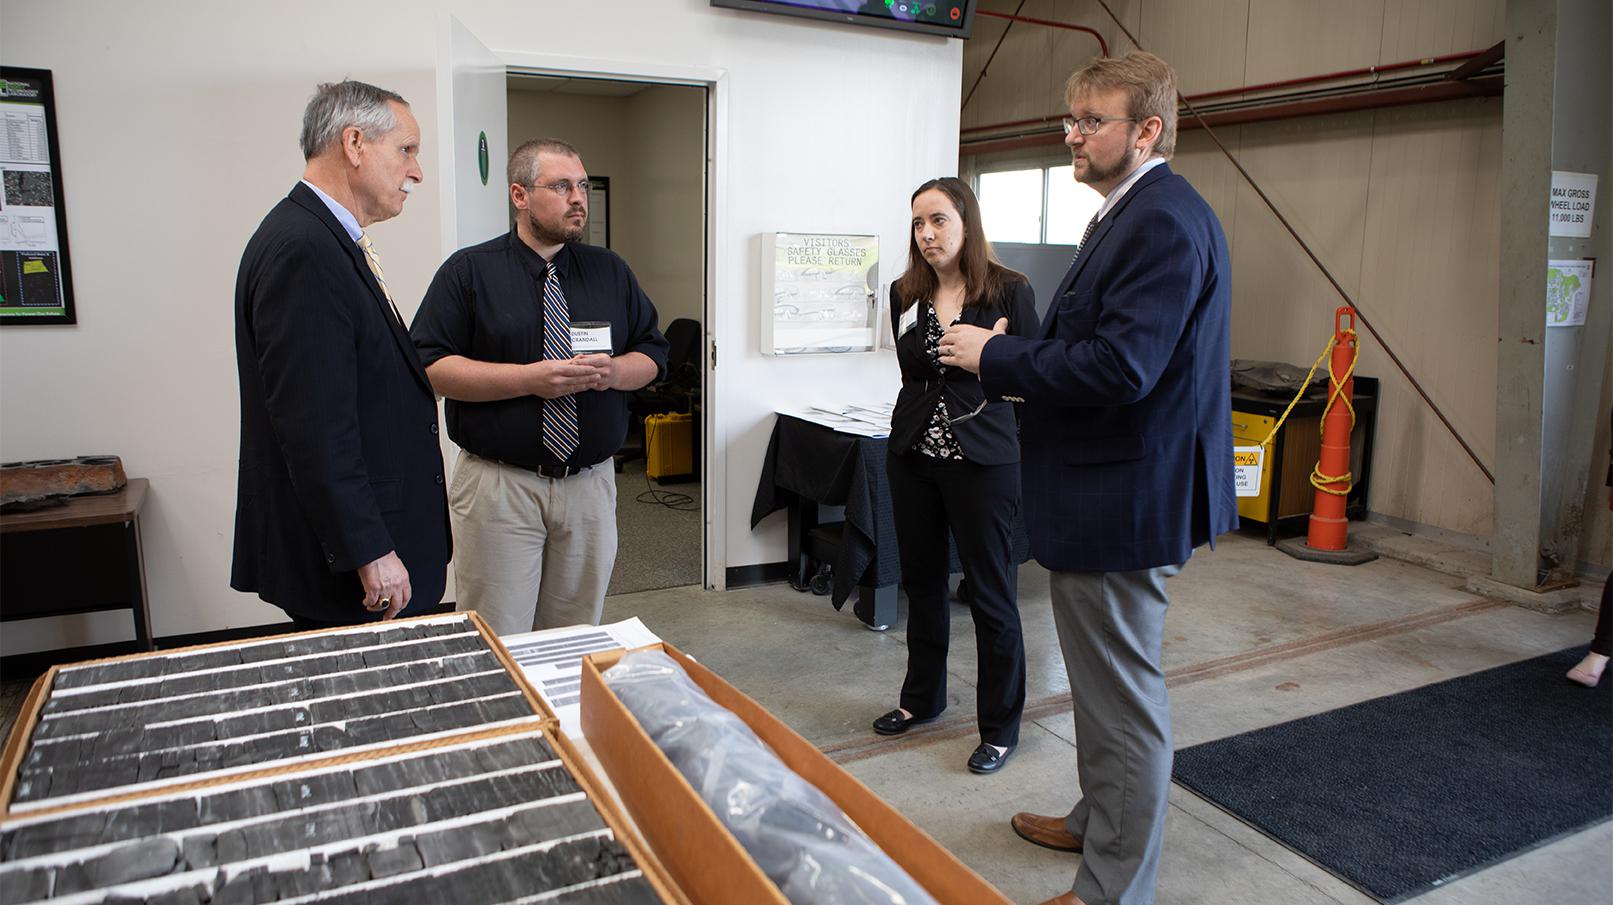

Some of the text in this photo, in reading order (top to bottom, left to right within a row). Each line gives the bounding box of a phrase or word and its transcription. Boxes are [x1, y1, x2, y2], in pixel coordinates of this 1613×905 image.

[1552, 188, 1590, 199] MAX GROSS
[1572, 202, 1590, 211] LOAD
[1571, 214, 1585, 223] LBS
[803, 238, 850, 247] VISITORS
[787, 246, 867, 257] SAFETY GLASSES
[788, 256, 861, 266] PLEASE RETURN
